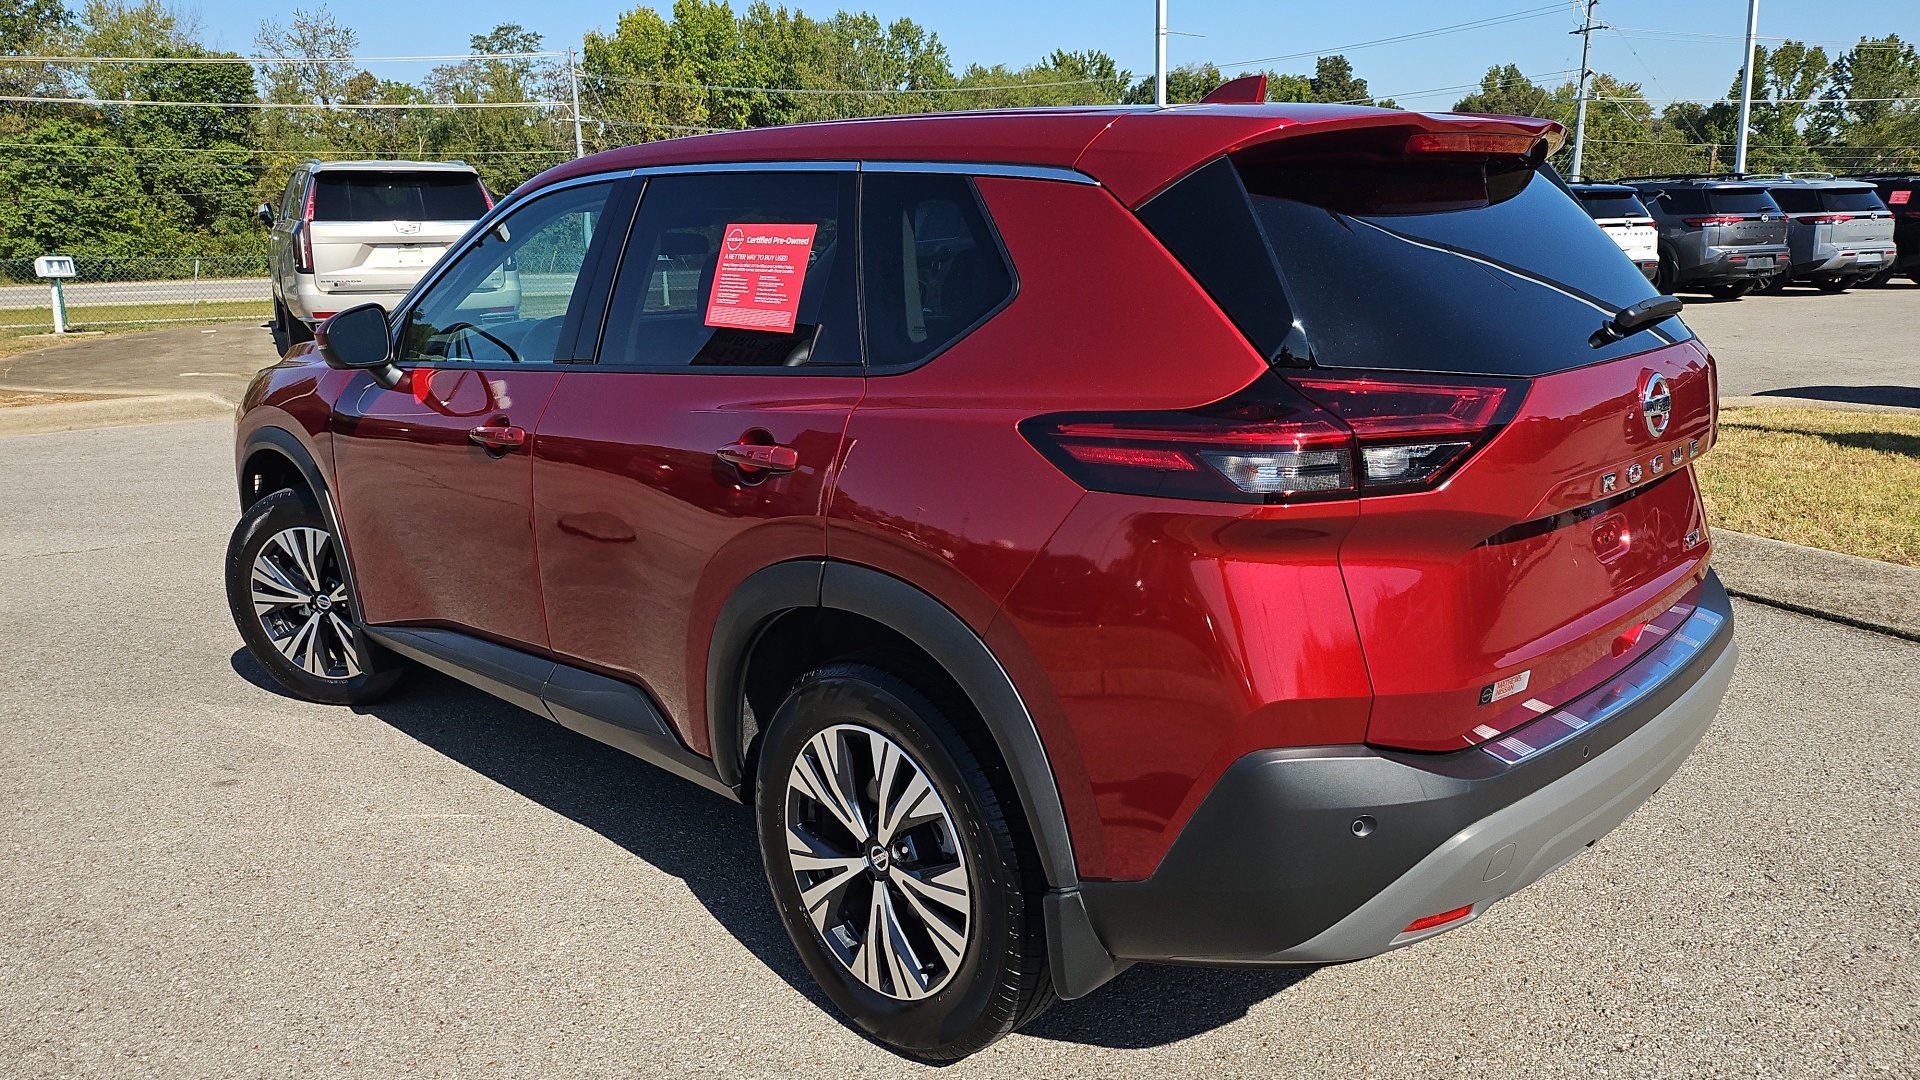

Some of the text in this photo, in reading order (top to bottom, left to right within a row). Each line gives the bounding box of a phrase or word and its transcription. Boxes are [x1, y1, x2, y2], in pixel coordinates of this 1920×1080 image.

[746, 236, 810, 245] Certified Pre-Owned
[1602, 439, 1699, 494] ROGUE
